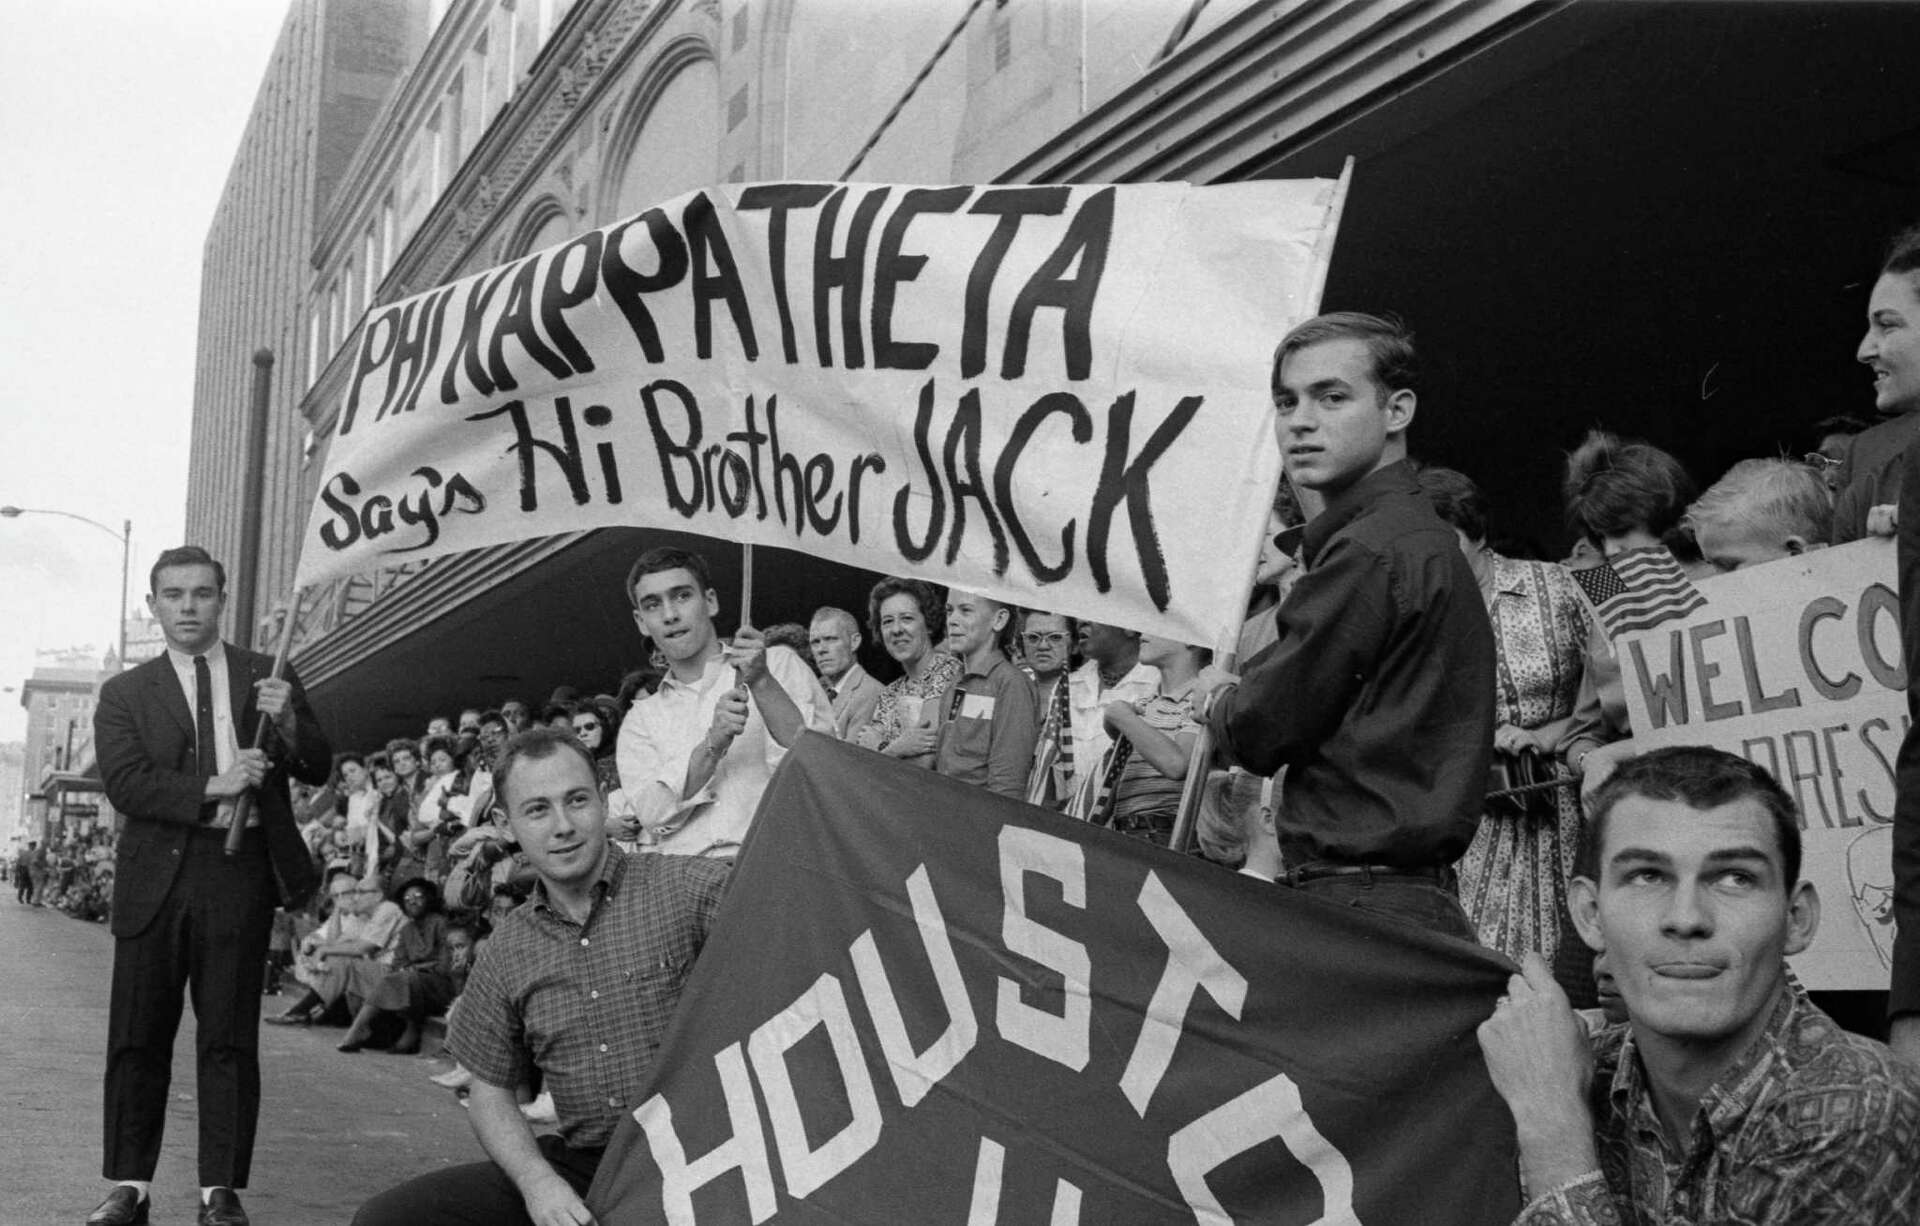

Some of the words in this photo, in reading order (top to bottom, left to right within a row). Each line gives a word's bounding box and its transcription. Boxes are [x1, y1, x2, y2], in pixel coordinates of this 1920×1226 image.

[340, 285, 457, 436] PHI
[441, 191, 759, 403] KAPPA
[734, 184, 1117, 381] THETA
[465, 396, 622, 512] Hi
[640, 379, 885, 544] Brother
[892, 377, 1205, 613] JACK
[1628, 582, 1908, 730] WELCO
[1742, 714, 1911, 830] RES
